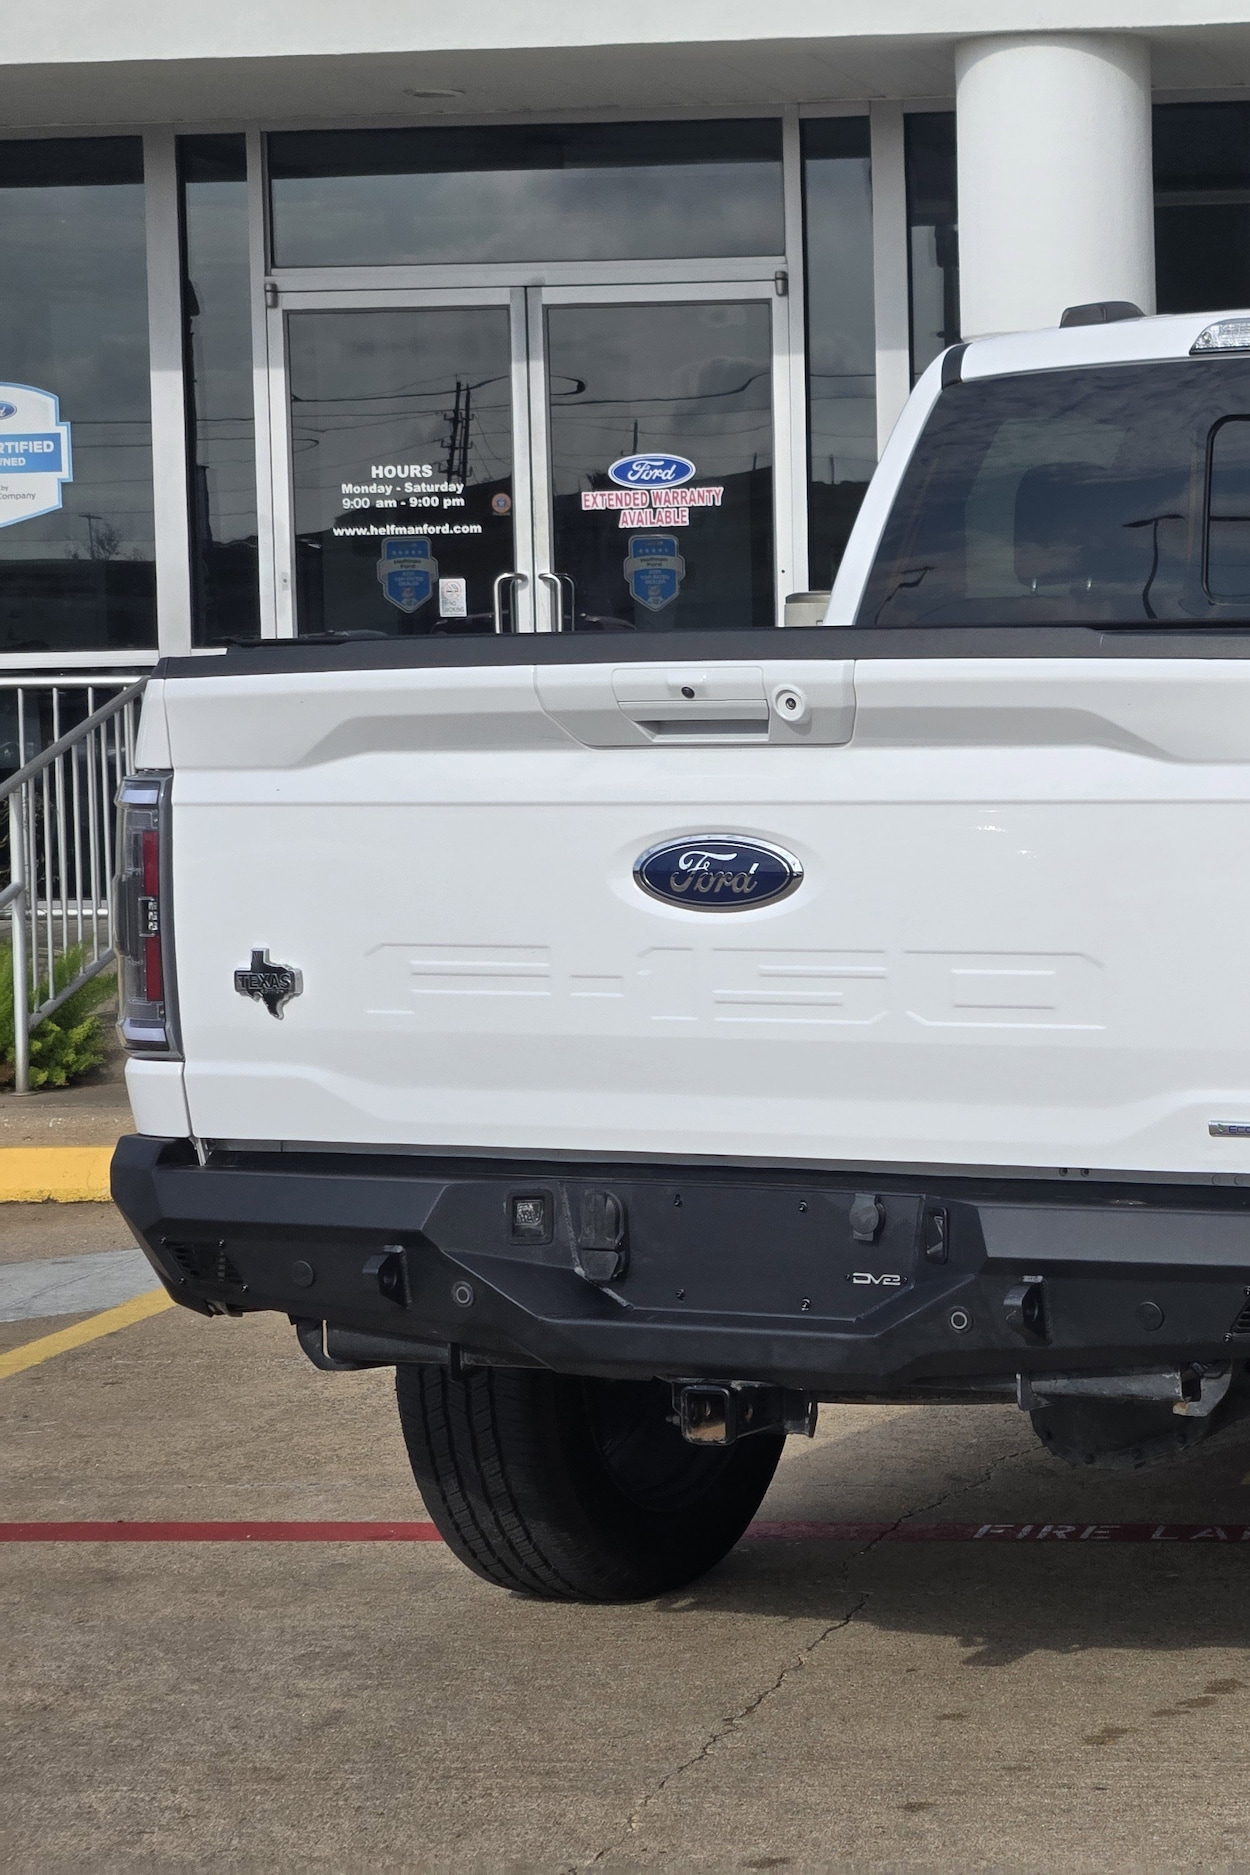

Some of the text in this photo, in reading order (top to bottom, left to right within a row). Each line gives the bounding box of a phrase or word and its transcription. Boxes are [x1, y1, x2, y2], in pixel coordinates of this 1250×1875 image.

[371, 464, 433, 478] HOURS
[341, 483, 392, 496] Monday
[404, 481, 464, 494] Saturday
[342, 497, 371, 509] 9:00
[375, 499, 397, 508] am
[409, 496, 440, 508] 9:00
[443, 499, 465, 510] pm
[582, 487, 724, 509] EXTENDED WARRANTY
[620, 509, 688, 527] AVAILABLE
[333, 523, 482, 536] www.helfmanford.com
[669, 850, 760, 894] Ford
[238, 972, 291, 990] TEXAS
[972, 1524, 1121, 1540] FIRE
